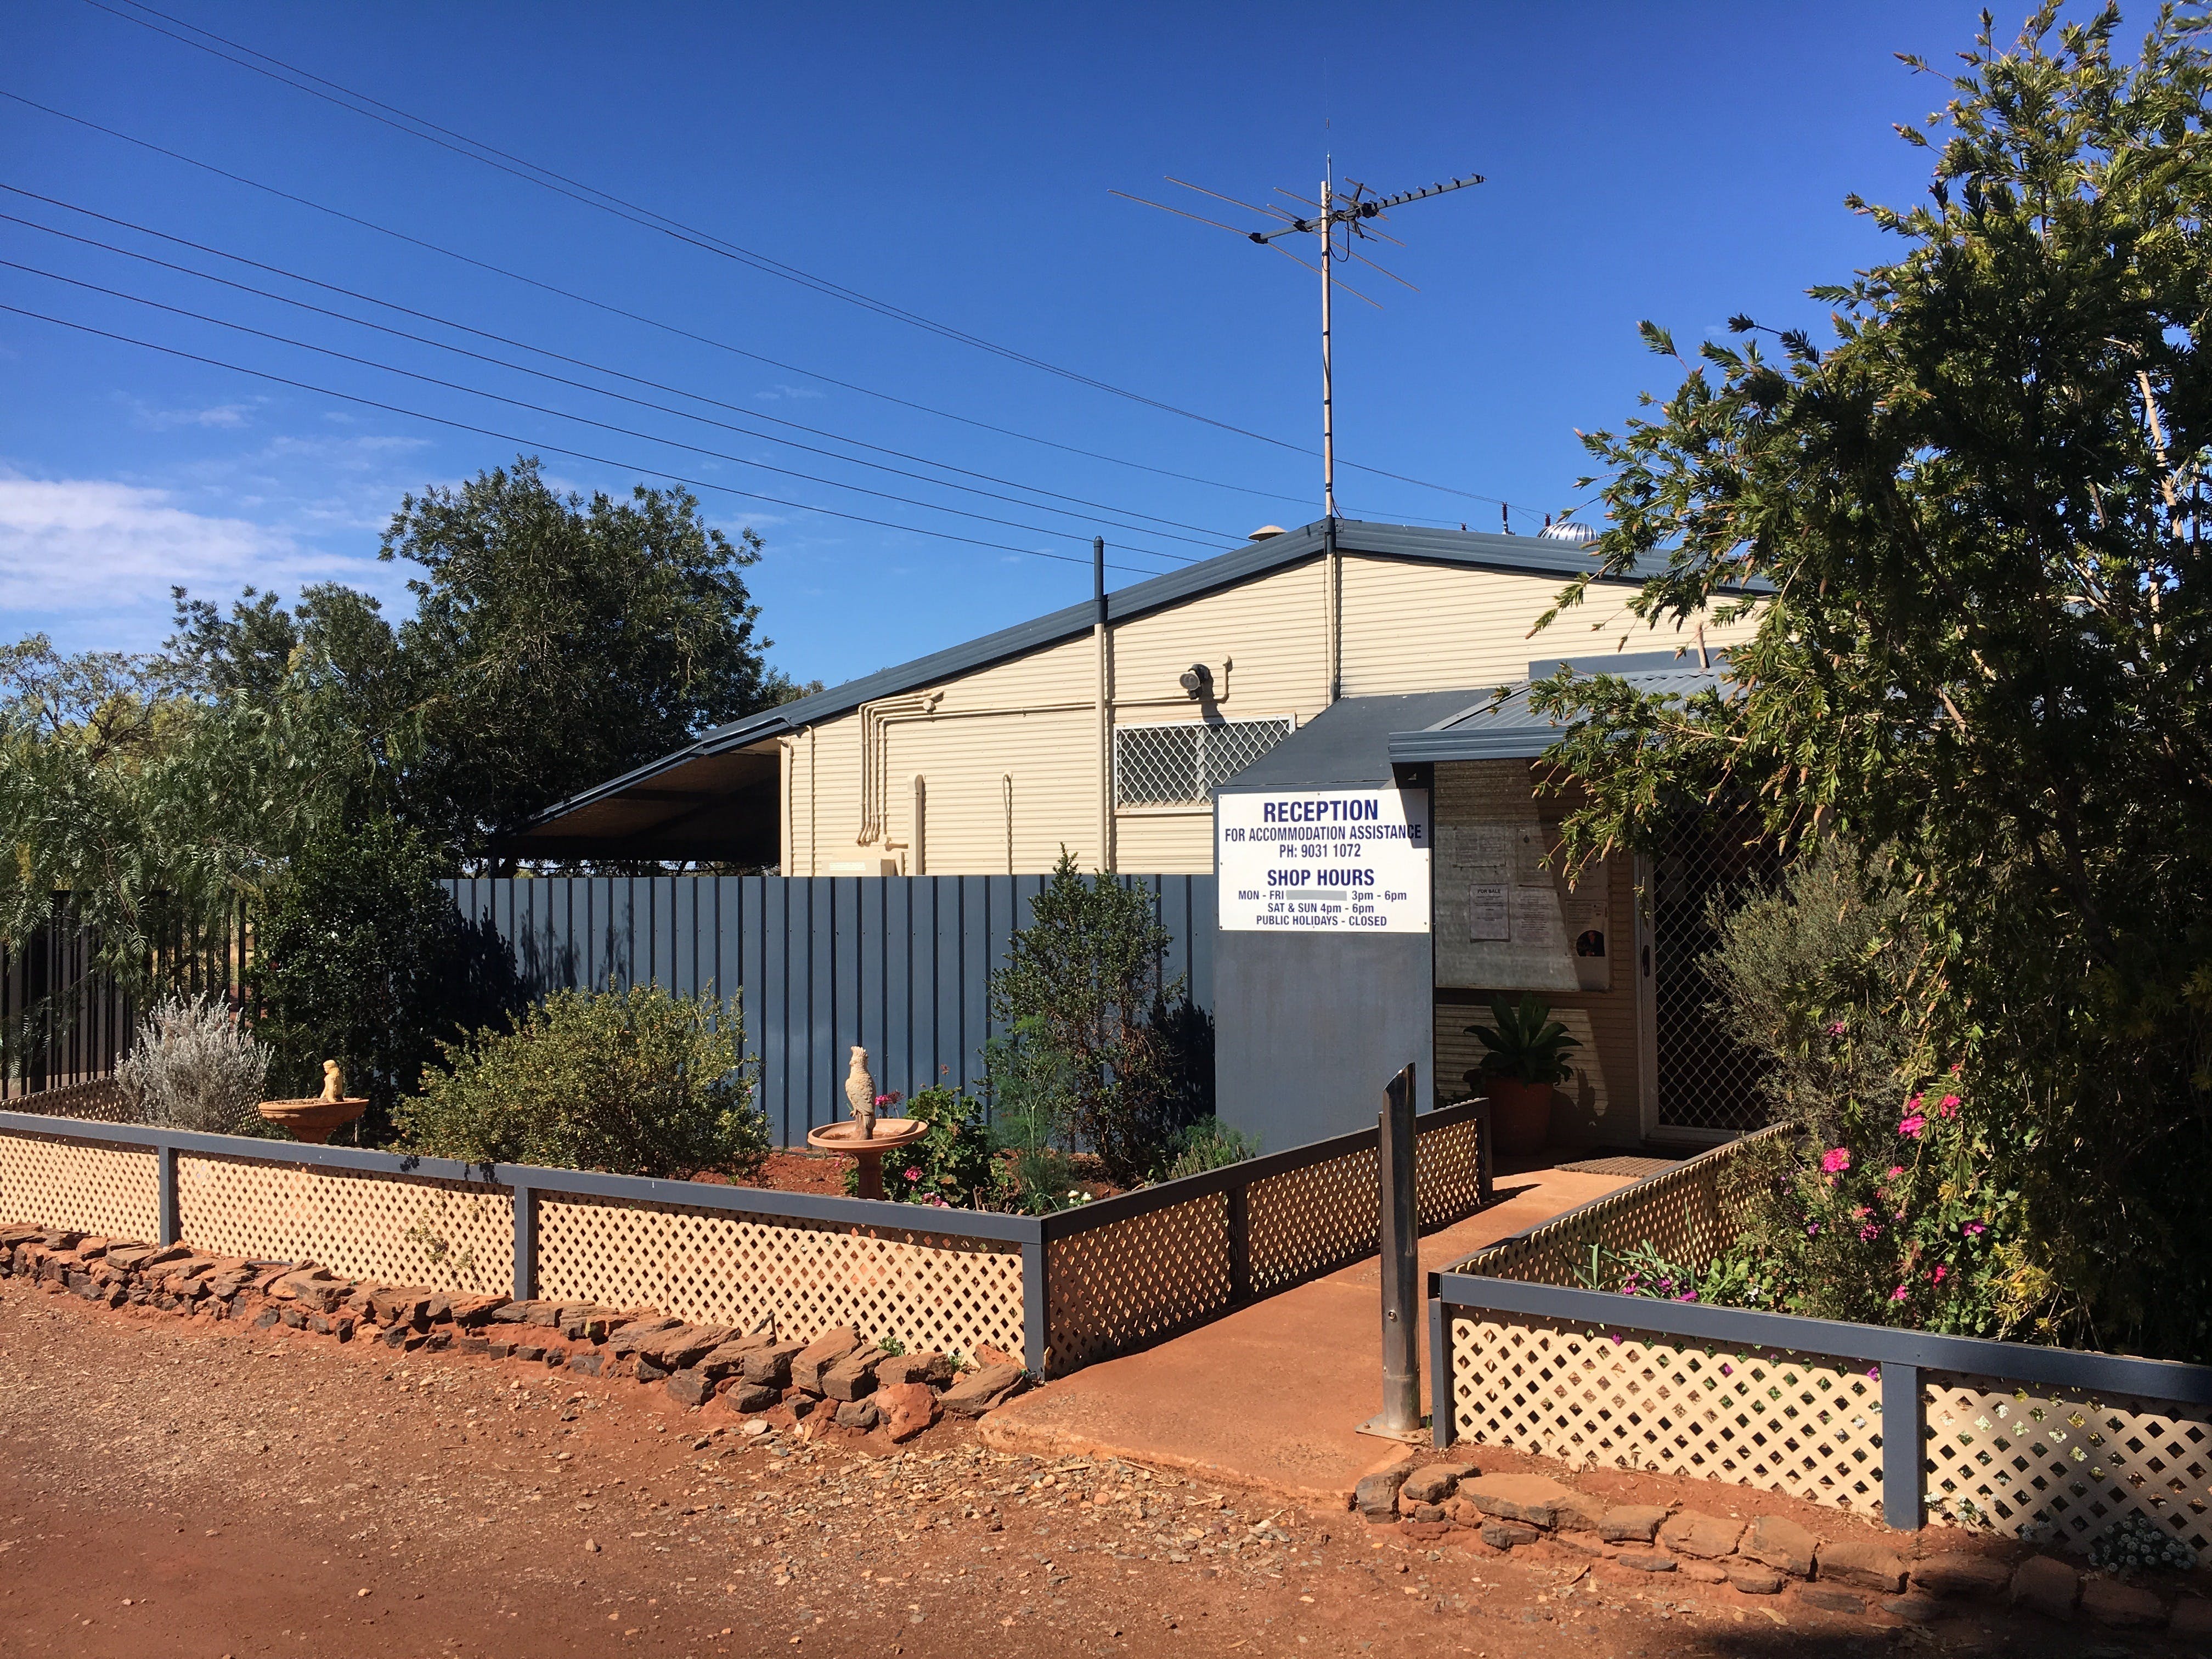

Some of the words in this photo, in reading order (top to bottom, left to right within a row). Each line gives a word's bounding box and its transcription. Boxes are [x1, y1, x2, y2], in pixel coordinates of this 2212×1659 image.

[1264, 799, 1378, 822] RECEPTION
[1226, 828, 1245, 842] FOR
[1249, 826, 1345, 841] ACCOMMODATION
[1350, 824, 1421, 840] ASSISTANCE
[1280, 844, 1296, 857] PH:
[1301, 844, 1327, 857] 9031
[1334, 844, 1361, 857] 1072
[1268, 870, 1311, 886] SHOP
[1318, 869, 1374, 885] HOURS
[1239, 890, 1259, 900] MON
[1270, 890, 1283, 899] FRI
[1352, 891, 1373, 902] 3pm
[1385, 891, 1406, 902] 6pm
[1268, 903, 1284, 912] SAT
[1288, 903, 1294, 912] &
[1299, 903, 1317, 912] SUN
[1321, 904, 1341, 915] 4pm
[1352, 904, 1374, 915] 6pm
[1257, 916, 1289, 925] PUBLIC
[1293, 916, 1338, 926] HOLIDAYS
[1349, 916, 1386, 926] CLOSED
